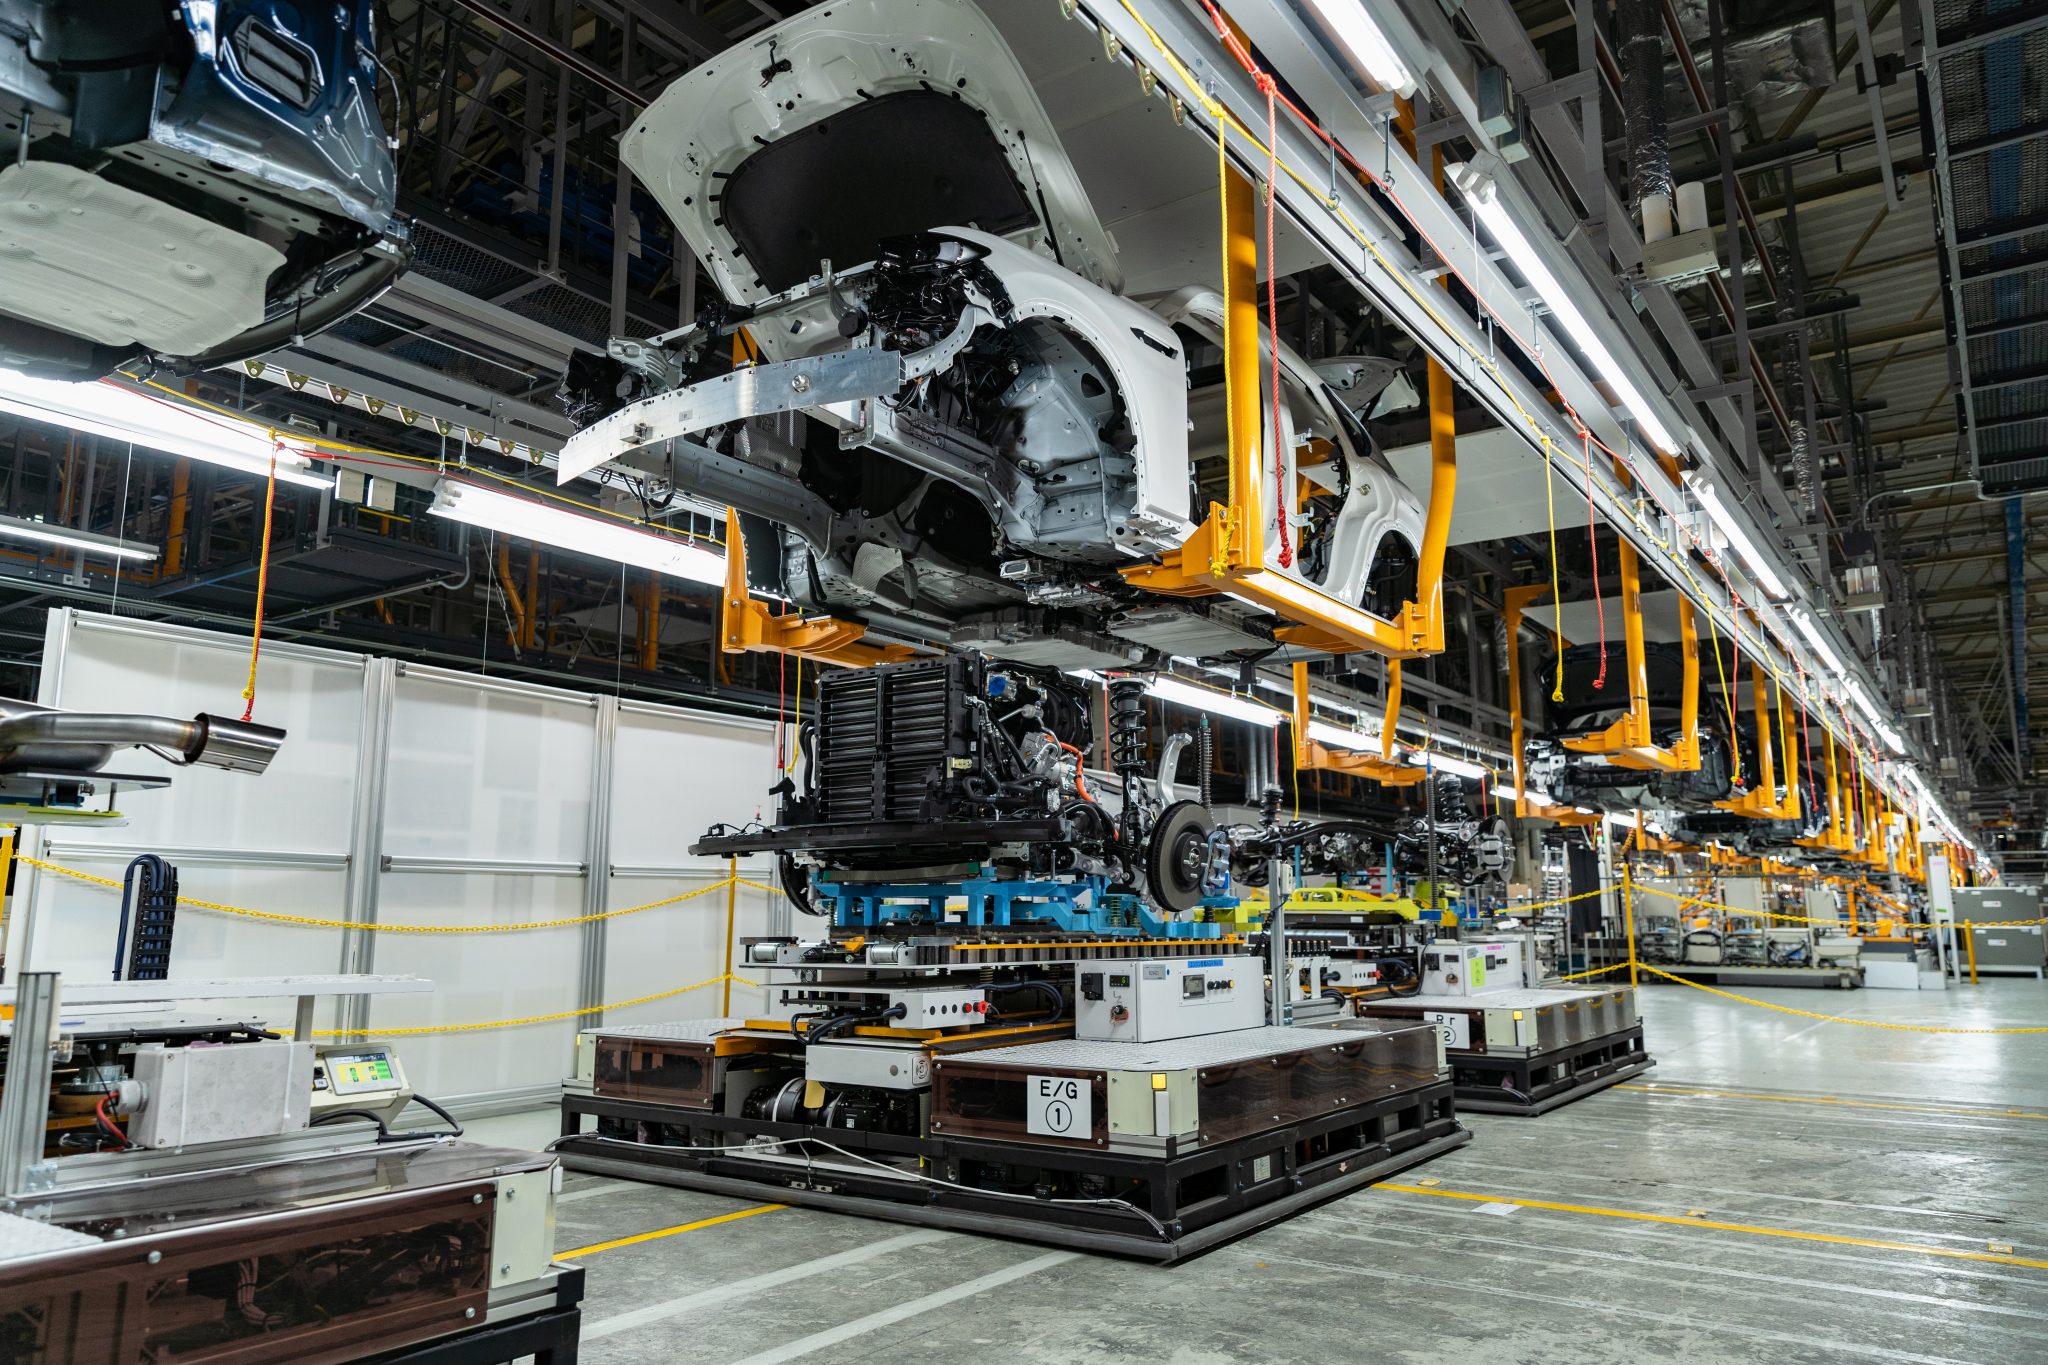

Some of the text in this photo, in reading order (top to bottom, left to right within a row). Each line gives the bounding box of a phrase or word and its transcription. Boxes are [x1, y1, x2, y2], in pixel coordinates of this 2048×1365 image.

[1444, 1030, 1451, 1042] 2
[1040, 1079, 1078, 1100] E/G
[1055, 1107, 1061, 1126] 1
